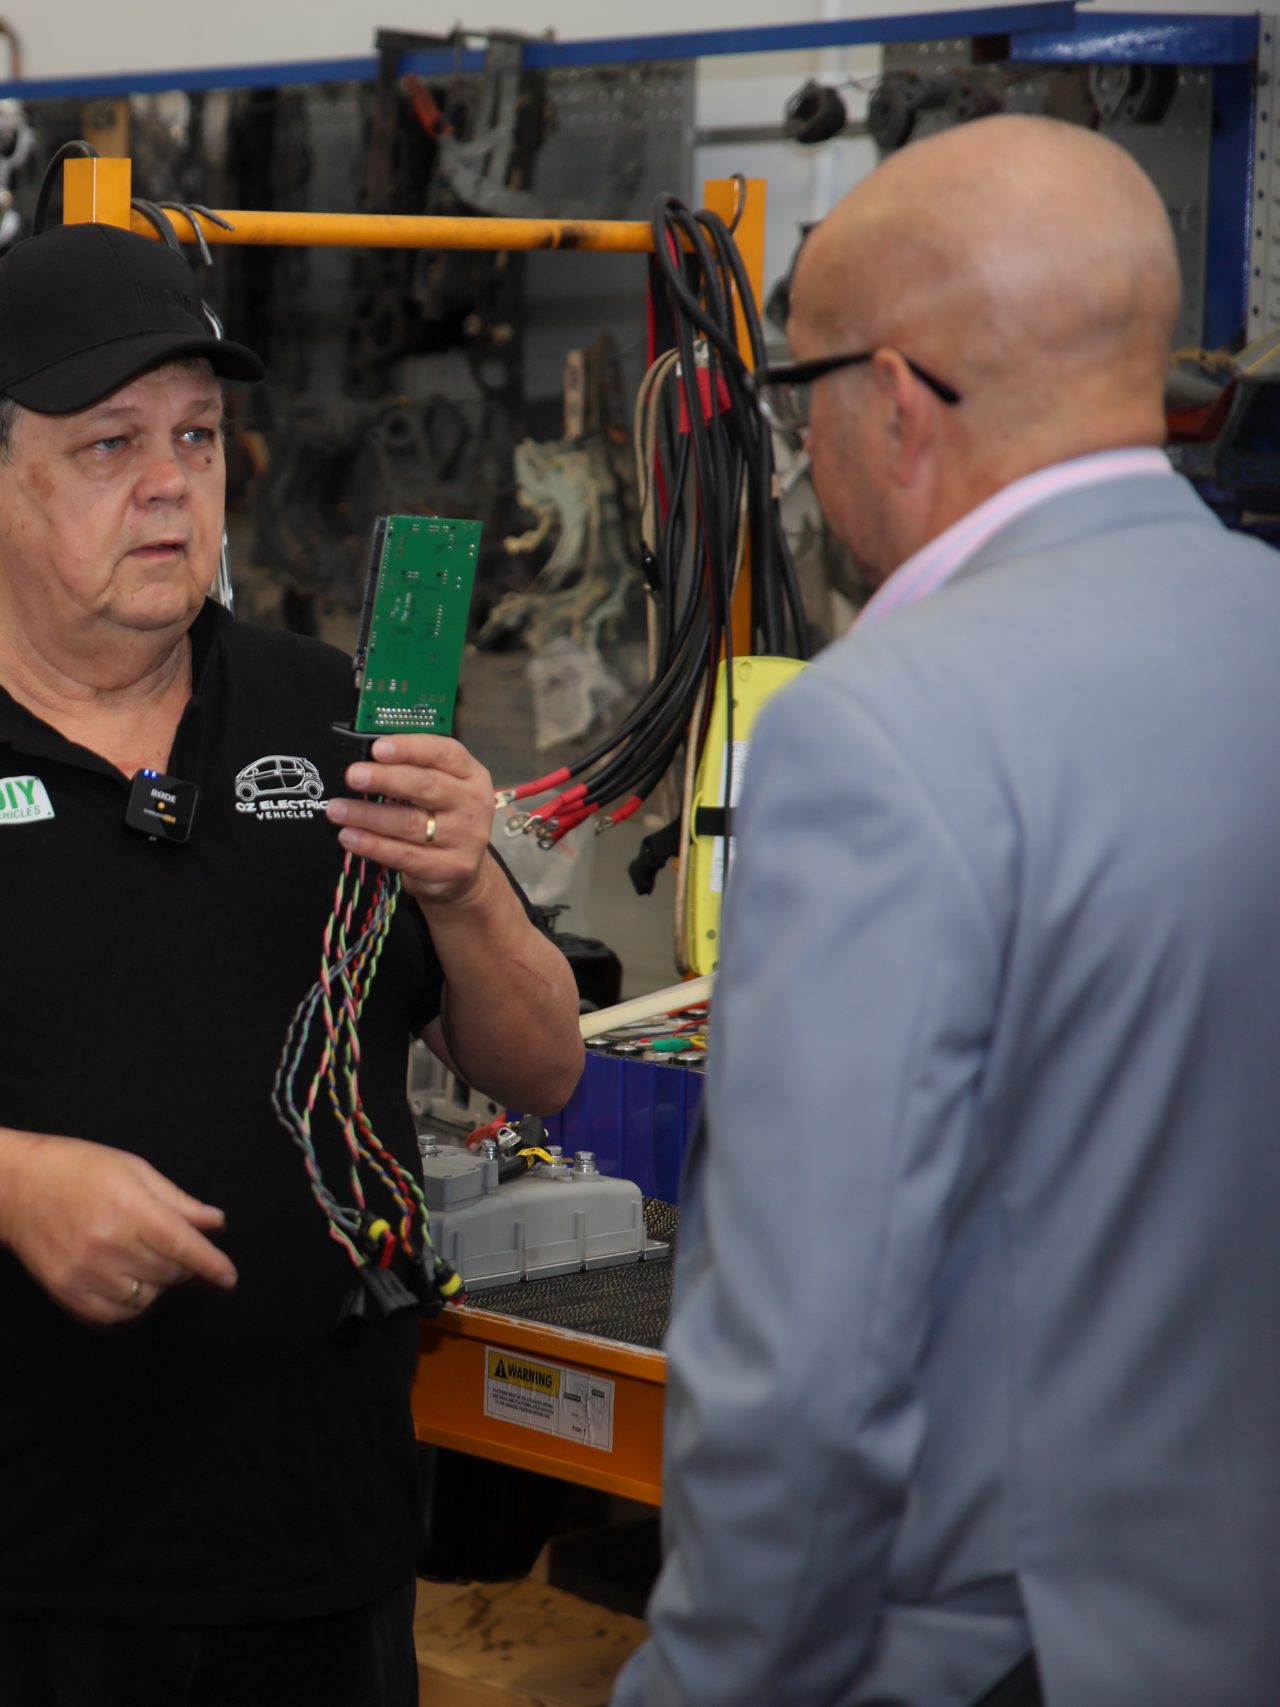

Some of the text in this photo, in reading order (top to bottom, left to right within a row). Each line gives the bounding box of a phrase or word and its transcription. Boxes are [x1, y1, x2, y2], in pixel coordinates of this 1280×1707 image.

[235, 799, 329, 812] OZ ELECTRIC
[256, 809, 314, 820] VEHICLES
[508, 1362, 553, 1388] WARNING
